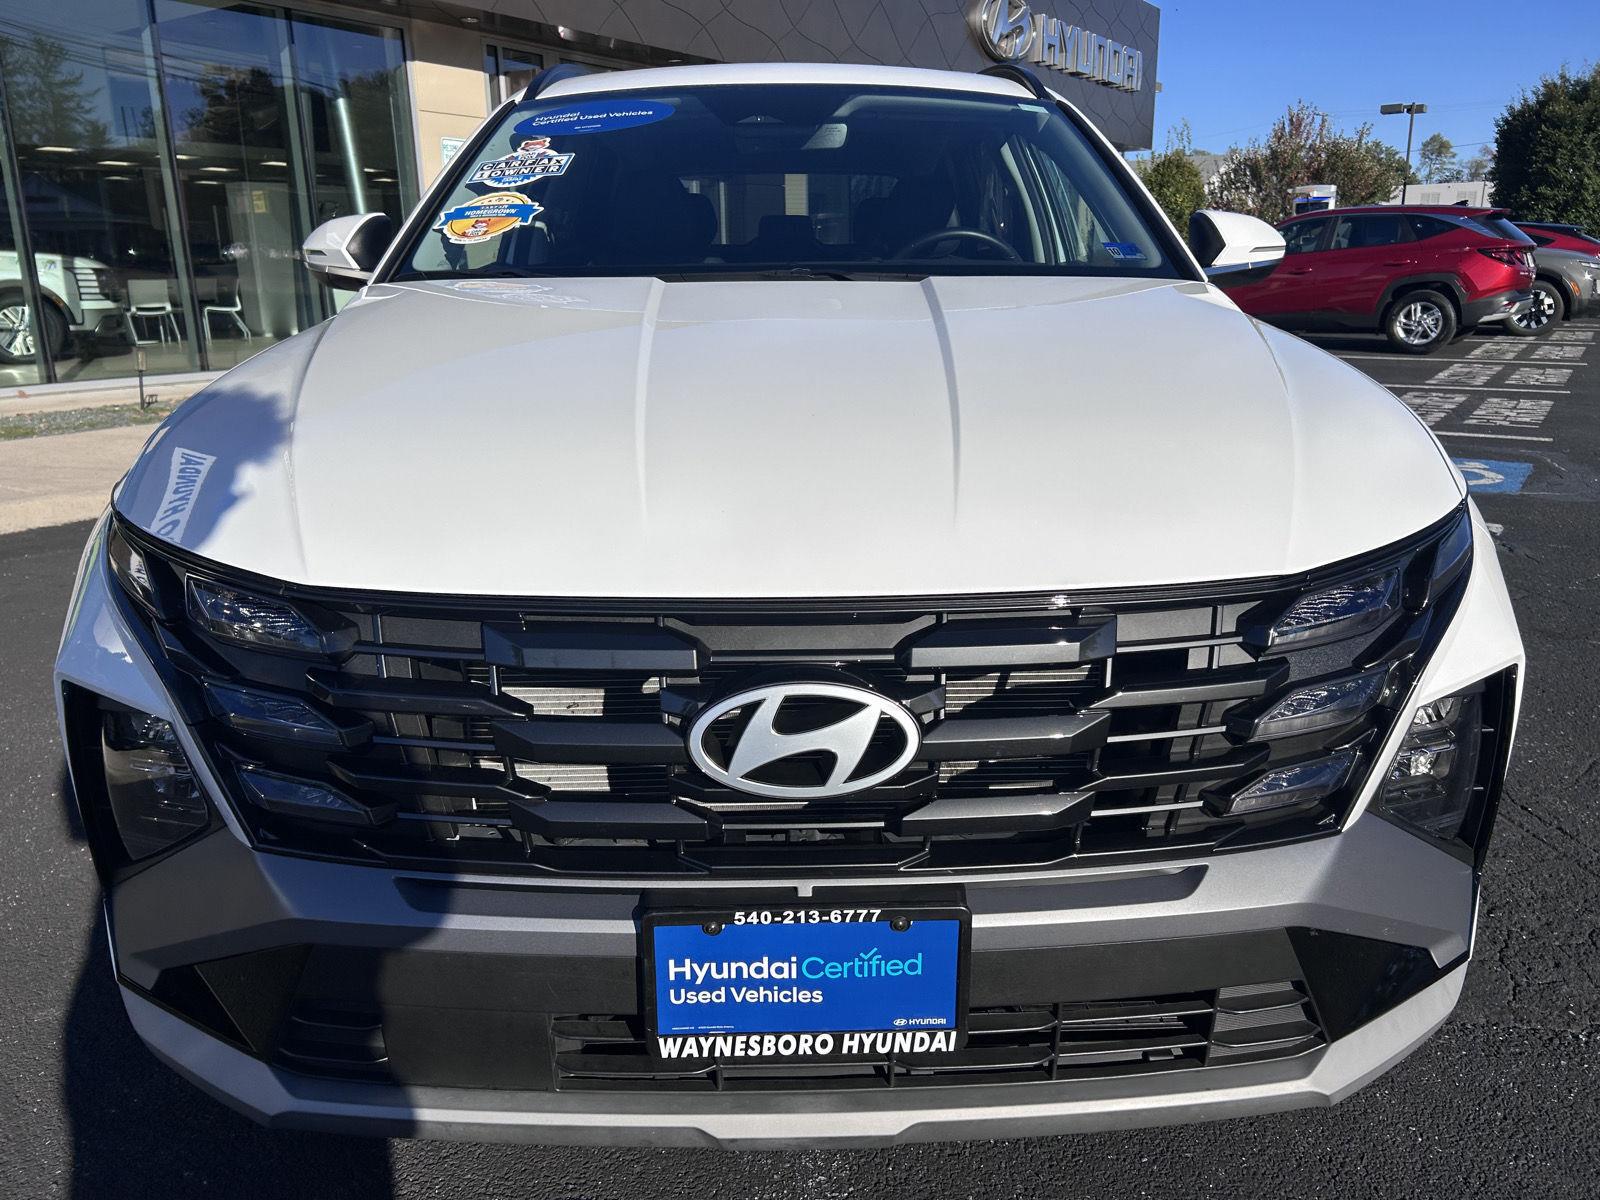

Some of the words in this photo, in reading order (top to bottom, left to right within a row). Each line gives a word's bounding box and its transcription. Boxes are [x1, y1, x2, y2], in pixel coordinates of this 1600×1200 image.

[1033, 13, 1142, 91] HYUNDAI
[532, 116, 578, 126] Certified
[609, 110, 654, 118] Vehicles
[535, 112, 580, 122] Hyundai
[482, 157, 564, 170] CARFAX
[490, 165, 560, 177] OWNER
[464, 208, 517, 216] HOMEGROWN
[733, 909, 882, 925] 540-213-6777
[668, 956, 797, 984] Hyundai
[801, 948, 923, 979] Certified
[669, 988, 726, 1005] Used
[730, 986, 824, 1003] Vehicles
[658, 1033, 834, 1059] WAYNESBORO
[842, 1031, 958, 1055] HYUNDAI
